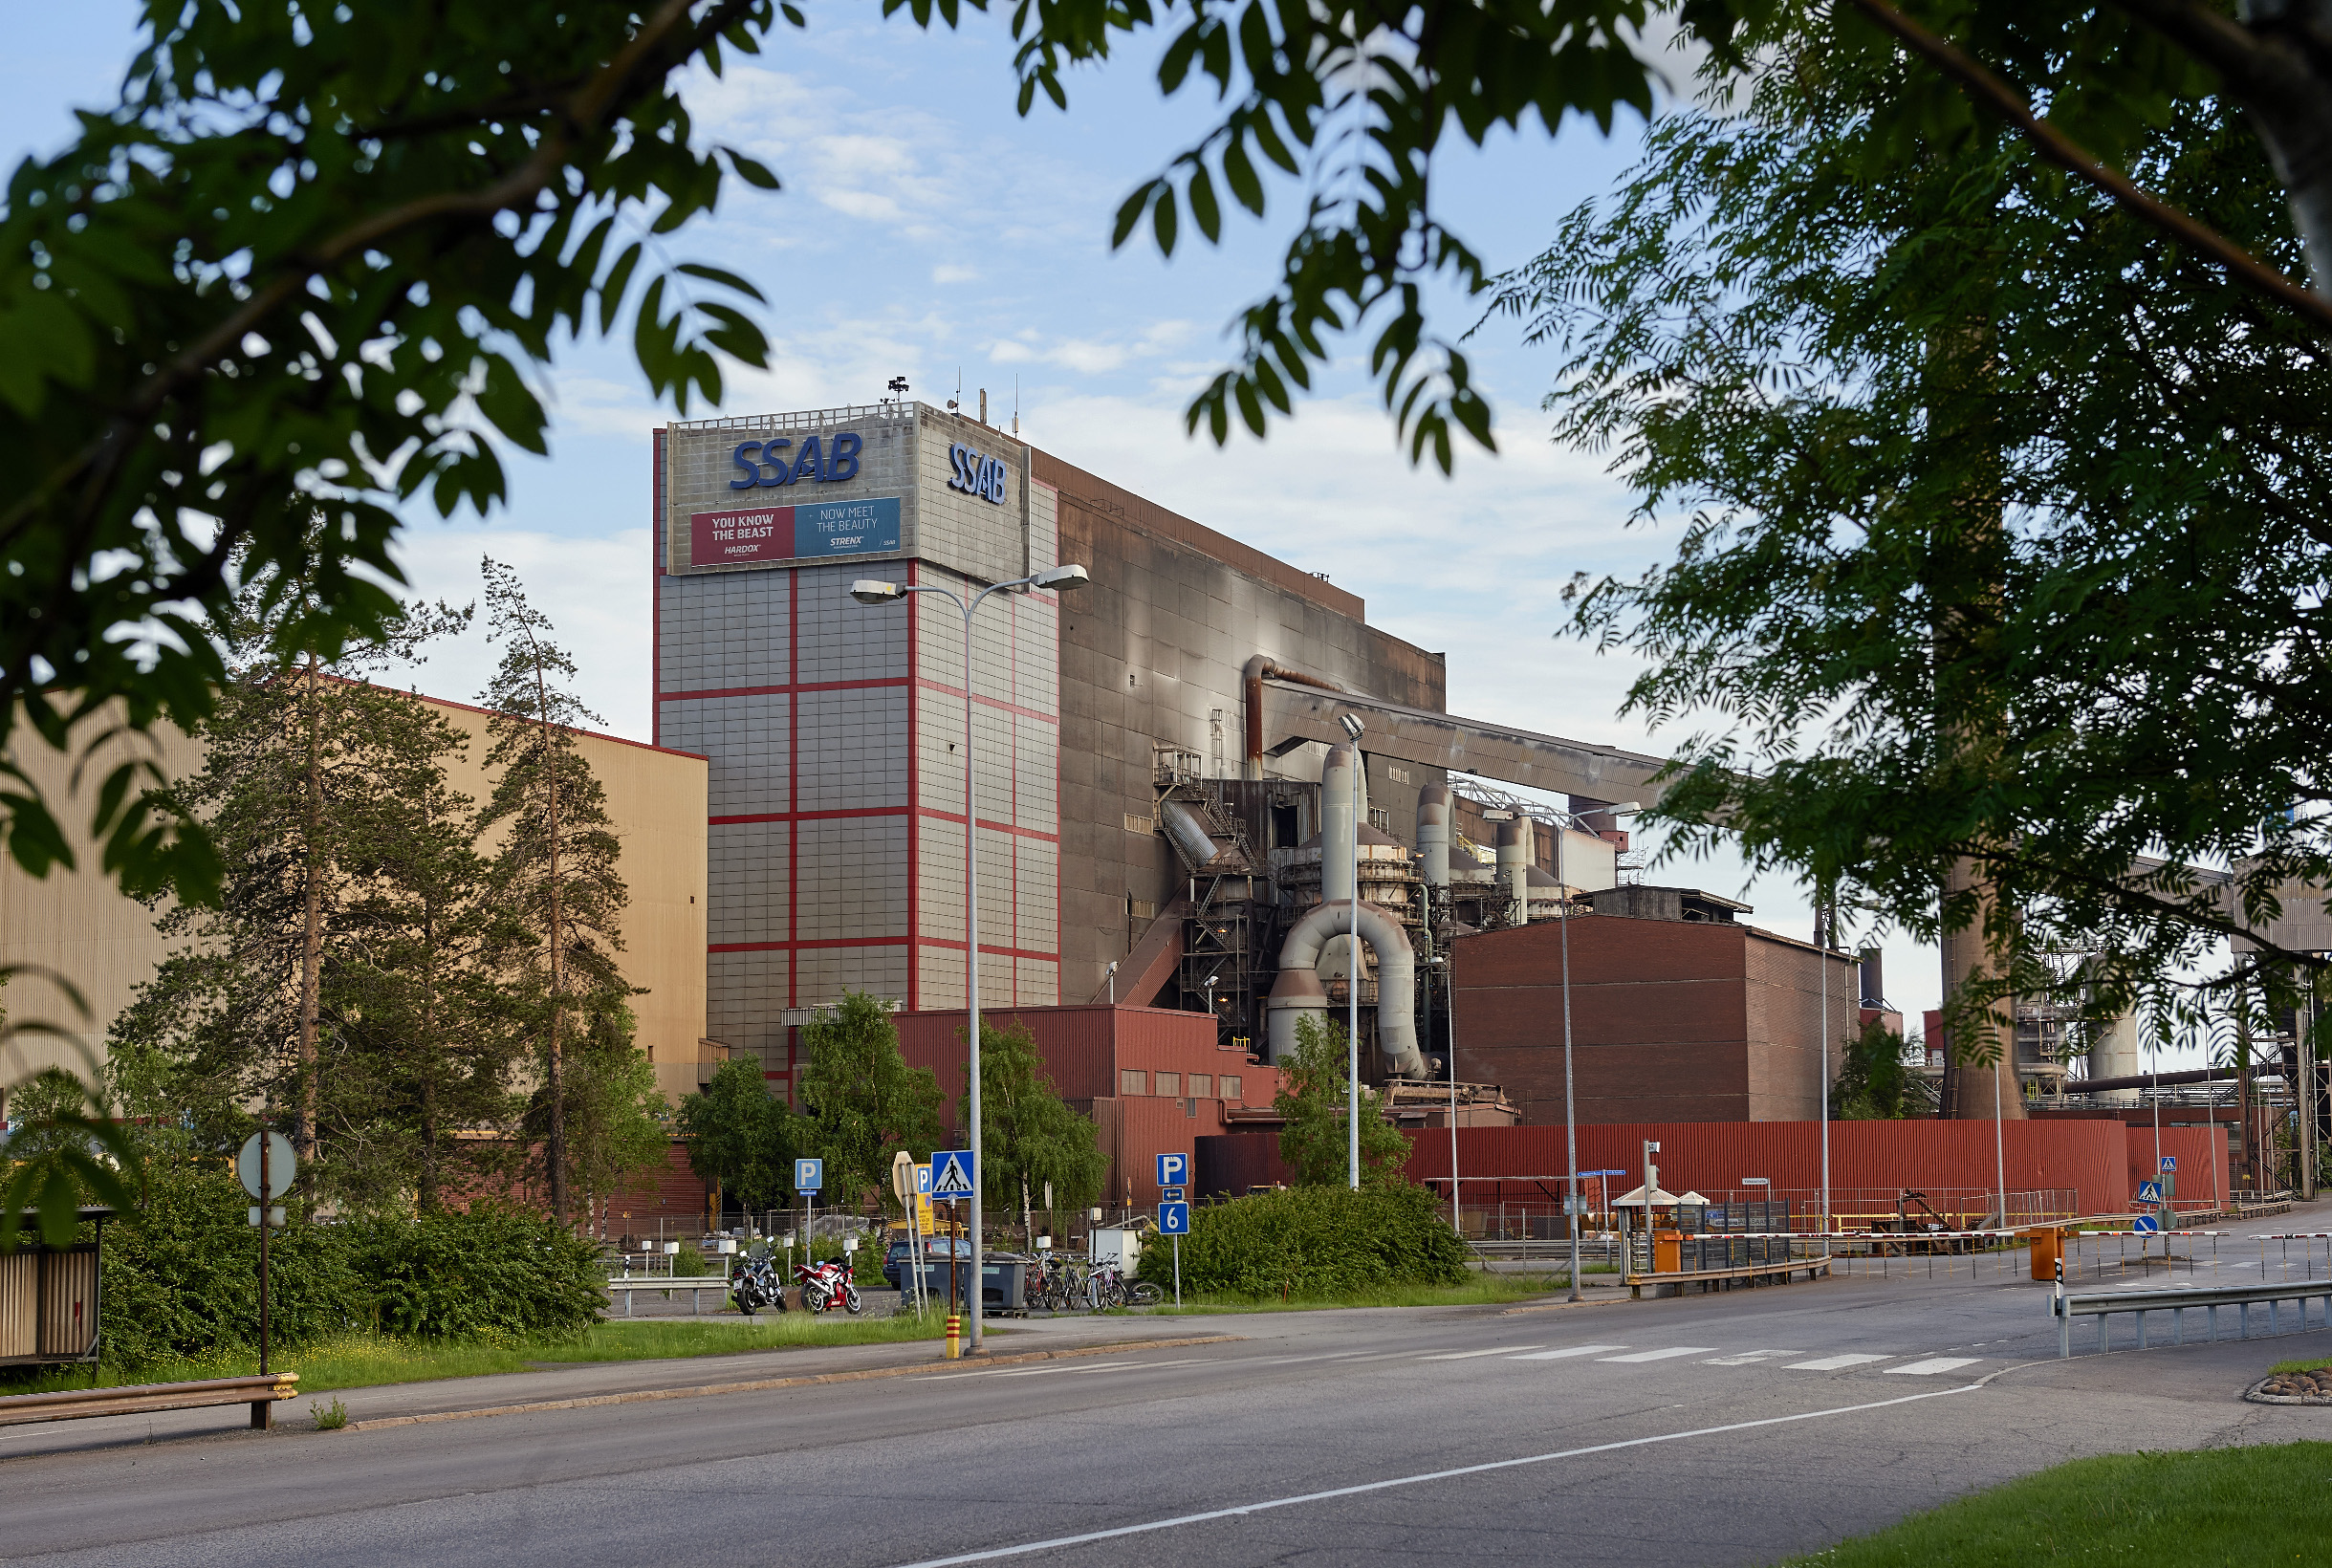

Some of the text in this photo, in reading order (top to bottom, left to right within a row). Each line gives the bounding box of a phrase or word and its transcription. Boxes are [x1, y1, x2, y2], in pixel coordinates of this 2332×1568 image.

[730, 433, 862, 490] SSAB
[950, 442, 1007, 505] SSAB
[712, 513, 774, 529] YOU KNOW
[820, 505, 875, 520] NOW MEET
[712, 526, 774, 541] THE BEAST
[817, 517, 878, 533] THE BEAUTY
[800, 1162, 817, 1186] P
[920, 1169, 928, 1191] P
[1163, 1156, 1183, 1184] P
[1166, 1207, 1179, 1230] 6
